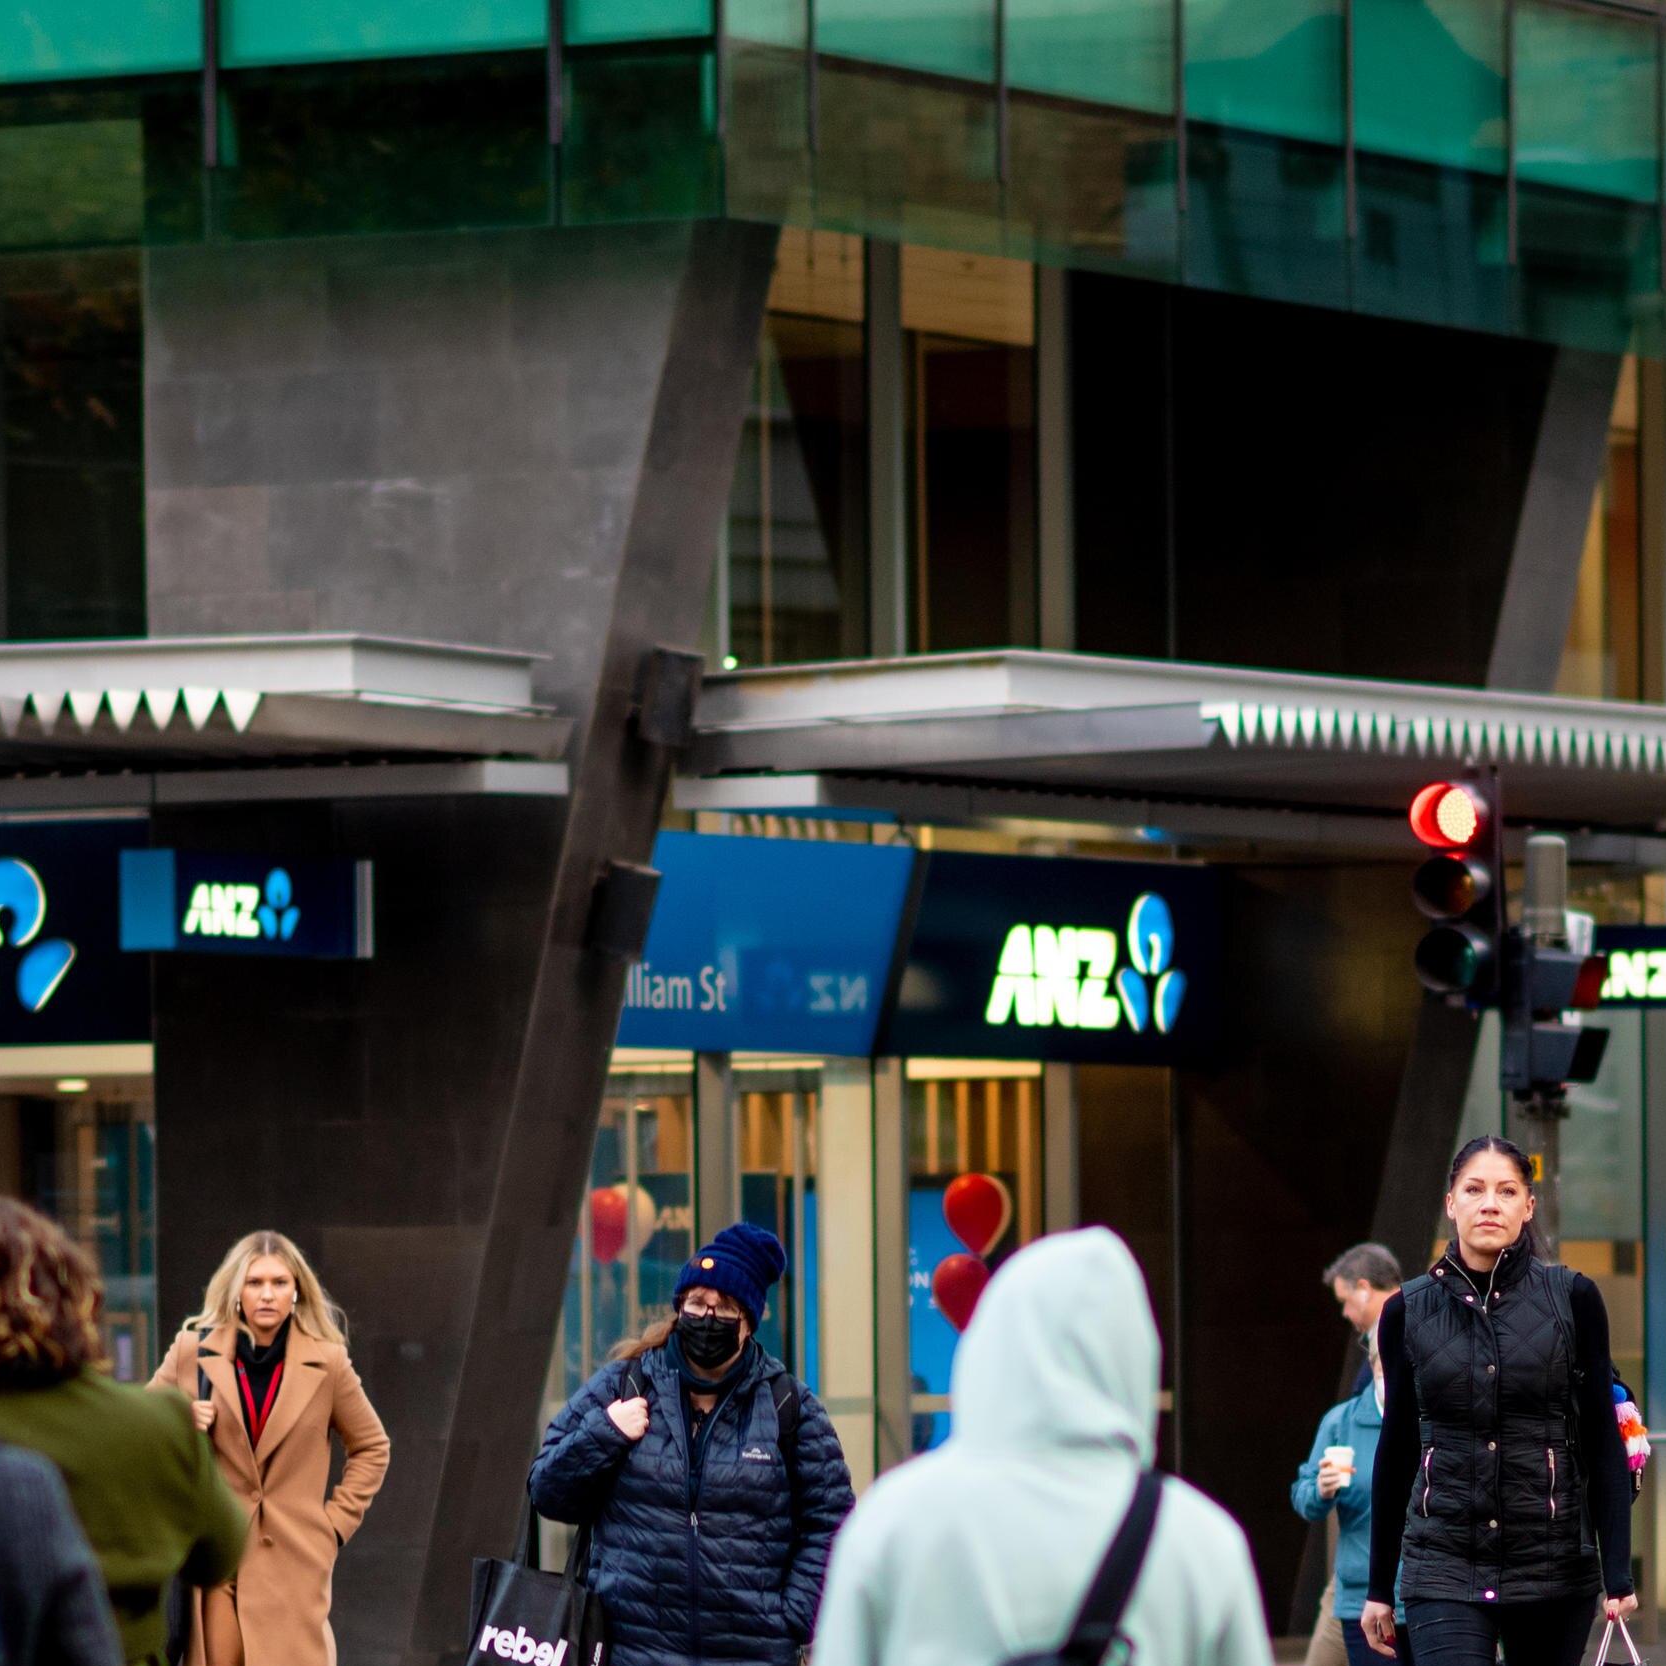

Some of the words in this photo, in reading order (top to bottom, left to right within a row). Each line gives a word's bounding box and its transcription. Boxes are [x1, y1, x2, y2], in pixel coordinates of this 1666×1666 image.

[182, 883, 260, 936] ANZ
[622, 963, 692, 1009] lliam
[700, 965, 727, 1012] St
[985, 924, 1121, 1030] ANZ
